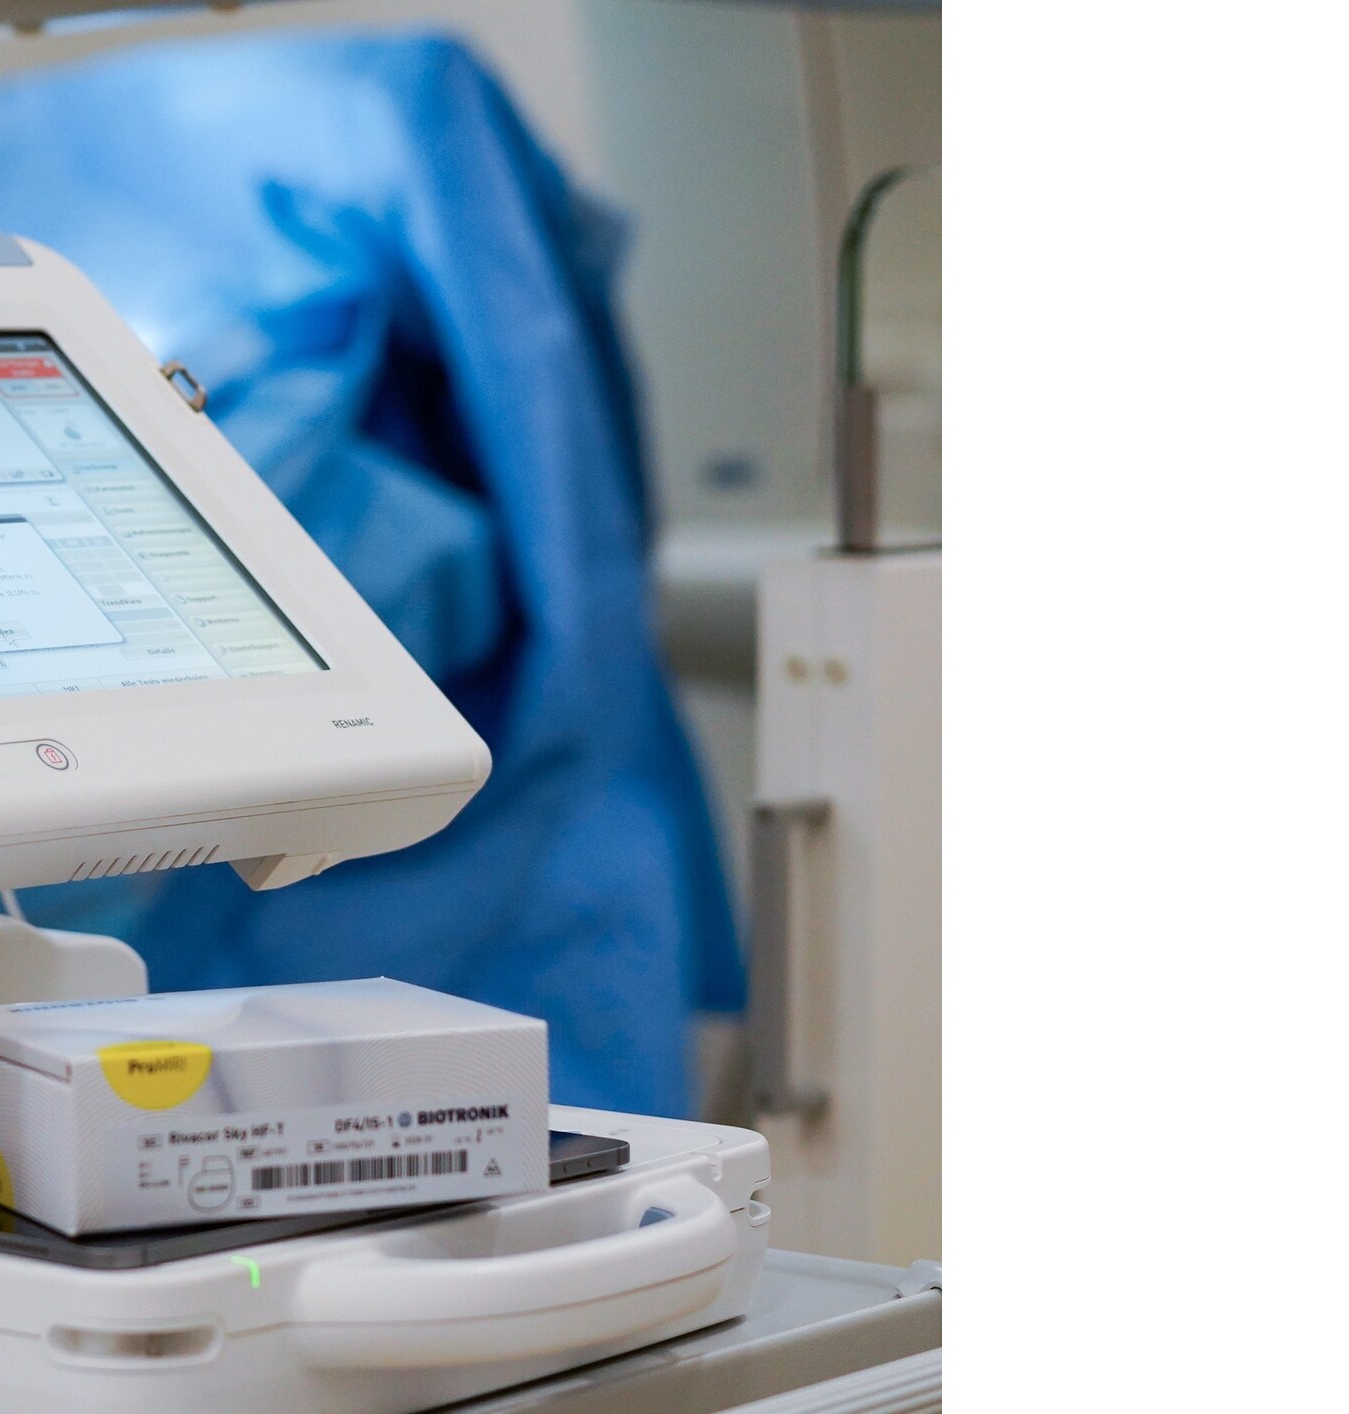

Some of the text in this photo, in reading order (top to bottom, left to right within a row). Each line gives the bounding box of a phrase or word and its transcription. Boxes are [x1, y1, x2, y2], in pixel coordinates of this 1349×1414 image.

[147, 647, 176, 656] Details
[122, 679, 137, 687] Alle
[138, 678, 160, 686] Tests
[331, 717, 374, 729] RENAMIC
[222, 1125, 248, 1142] Sky
[334, 1115, 395, 1134] DF4/IS-1
[417, 1103, 510, 1126] BIOTRONIK
